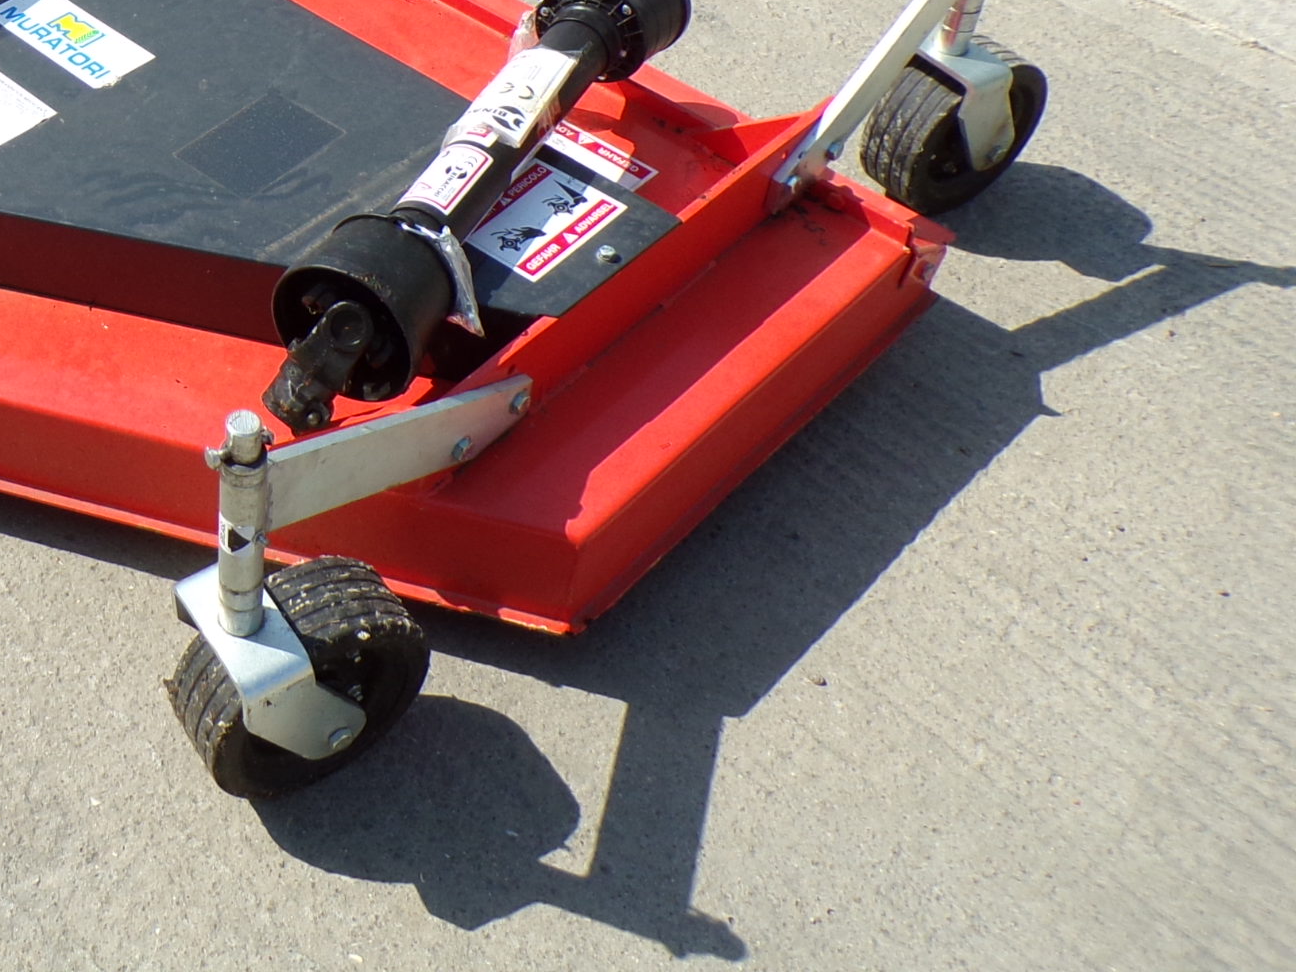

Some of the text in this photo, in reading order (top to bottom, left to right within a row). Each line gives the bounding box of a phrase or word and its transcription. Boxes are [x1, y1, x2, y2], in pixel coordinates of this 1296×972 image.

[0, 6, 111, 79] MURATORI
[509, 166, 547, 197] PERICOLO
[597, 146, 640, 173] GEFAHR
[526, 203, 614, 271] GEFAHR ADVARSEL
